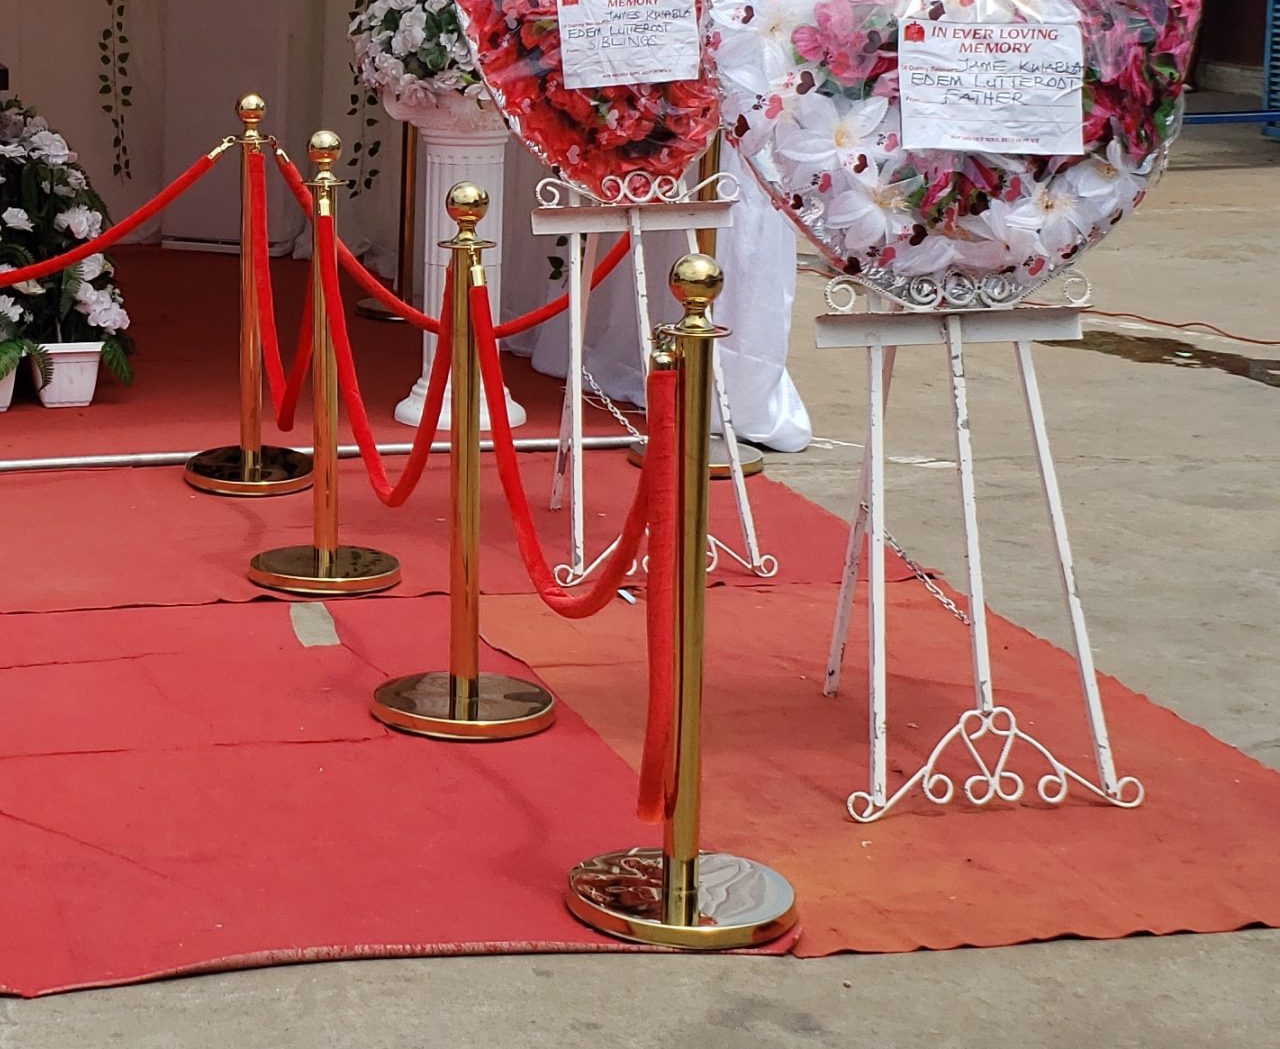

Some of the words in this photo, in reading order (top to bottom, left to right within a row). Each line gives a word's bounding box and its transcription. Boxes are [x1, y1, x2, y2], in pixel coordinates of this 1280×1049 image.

[568, 27, 601, 39] EDEM
[931, 26, 947, 39] IN
[953, 28, 993, 39] EVER
[1000, 28, 1059, 40] LOVING
[589, 35, 657, 50] SIBLINGS
[959, 43, 1032, 54] MEMORY
[911, 73, 962, 86] EDEM
[975, 75, 1081, 89] LUTTERODT
[942, 89, 1025, 105] FATHER
